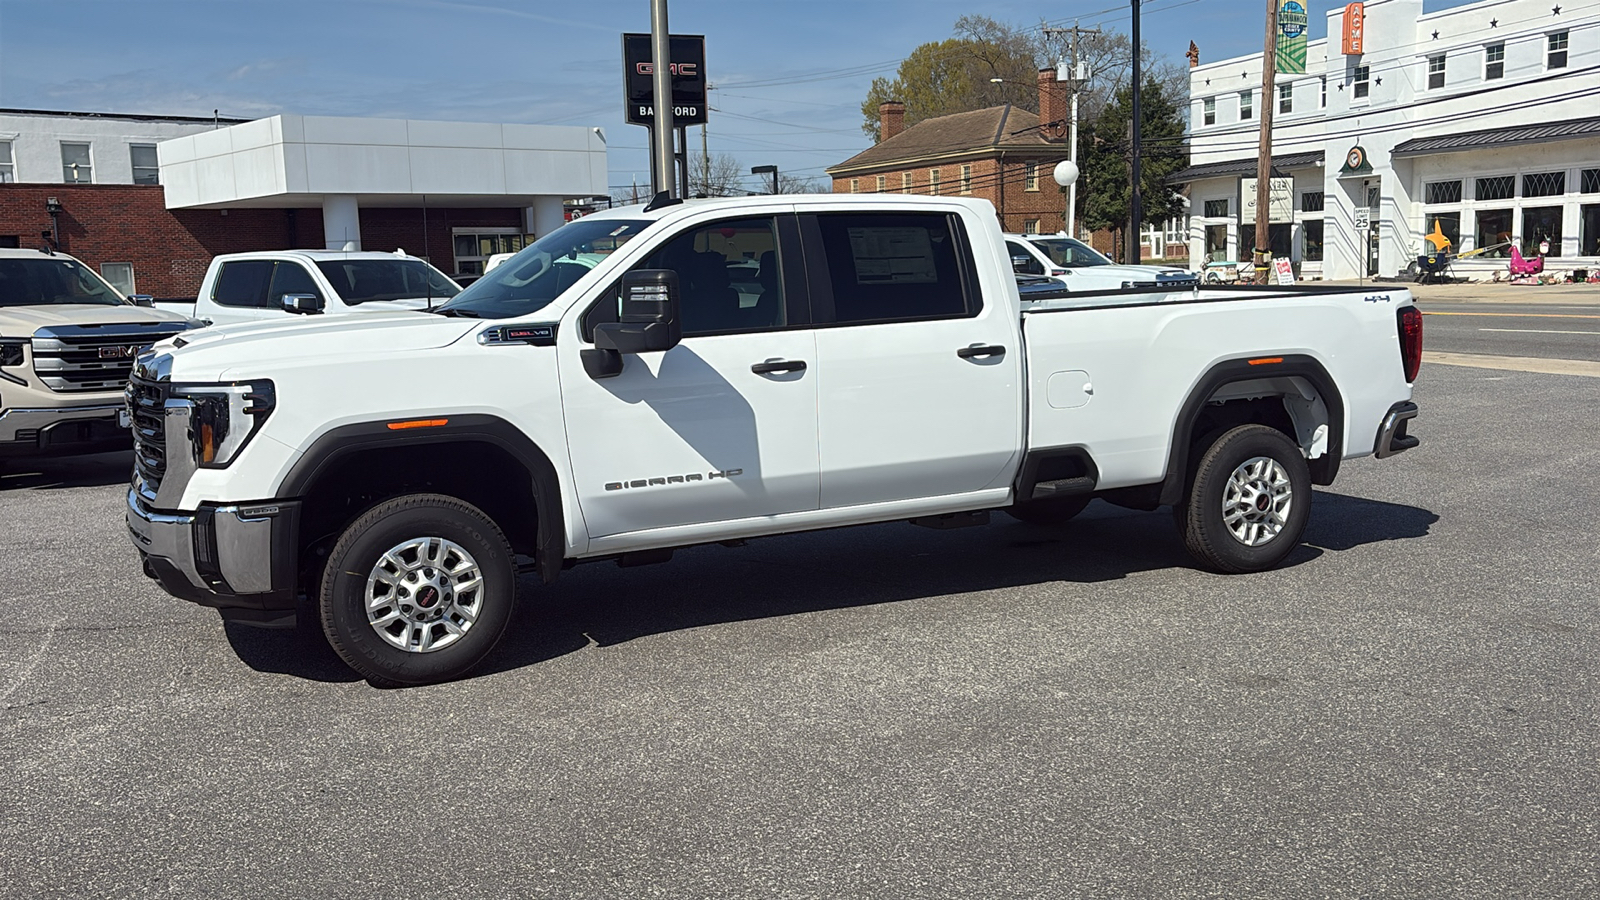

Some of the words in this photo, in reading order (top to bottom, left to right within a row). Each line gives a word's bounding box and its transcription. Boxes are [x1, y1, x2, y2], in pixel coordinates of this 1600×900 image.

[1351, 6, 1361, 51] ACME
[1355, 218, 1369, 228] 25
[98, 345, 139, 358] GM
[604, 473, 703, 491] SIERRA
[708, 468, 743, 480] HD
